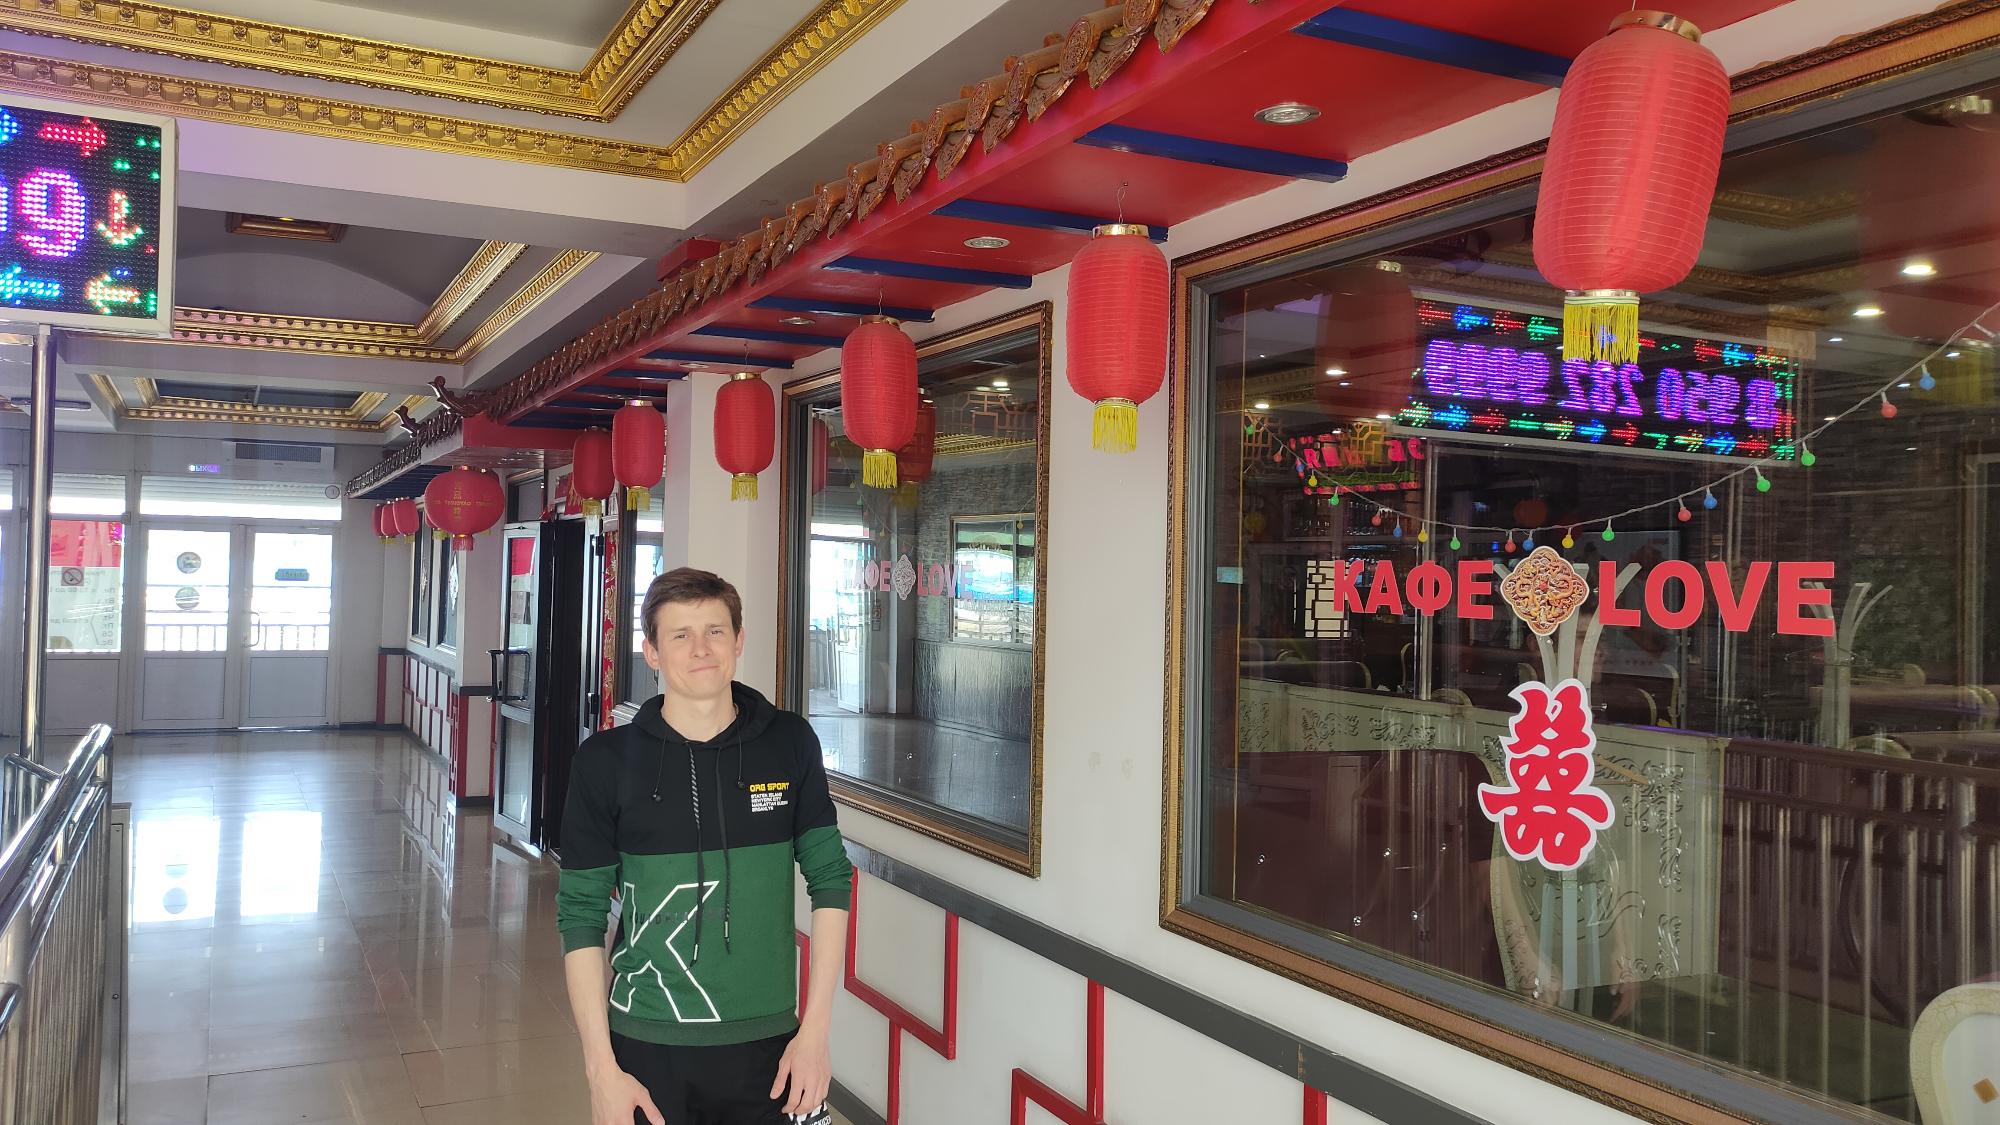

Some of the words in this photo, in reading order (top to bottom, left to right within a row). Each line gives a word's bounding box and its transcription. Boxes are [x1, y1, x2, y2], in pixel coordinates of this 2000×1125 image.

[917, 560, 974, 600] LOVE
[1332, 560, 1495, 620] КАФЕ
[1599, 560, 1836, 637] LOVE
[767, 782, 790, 791] SPORT
